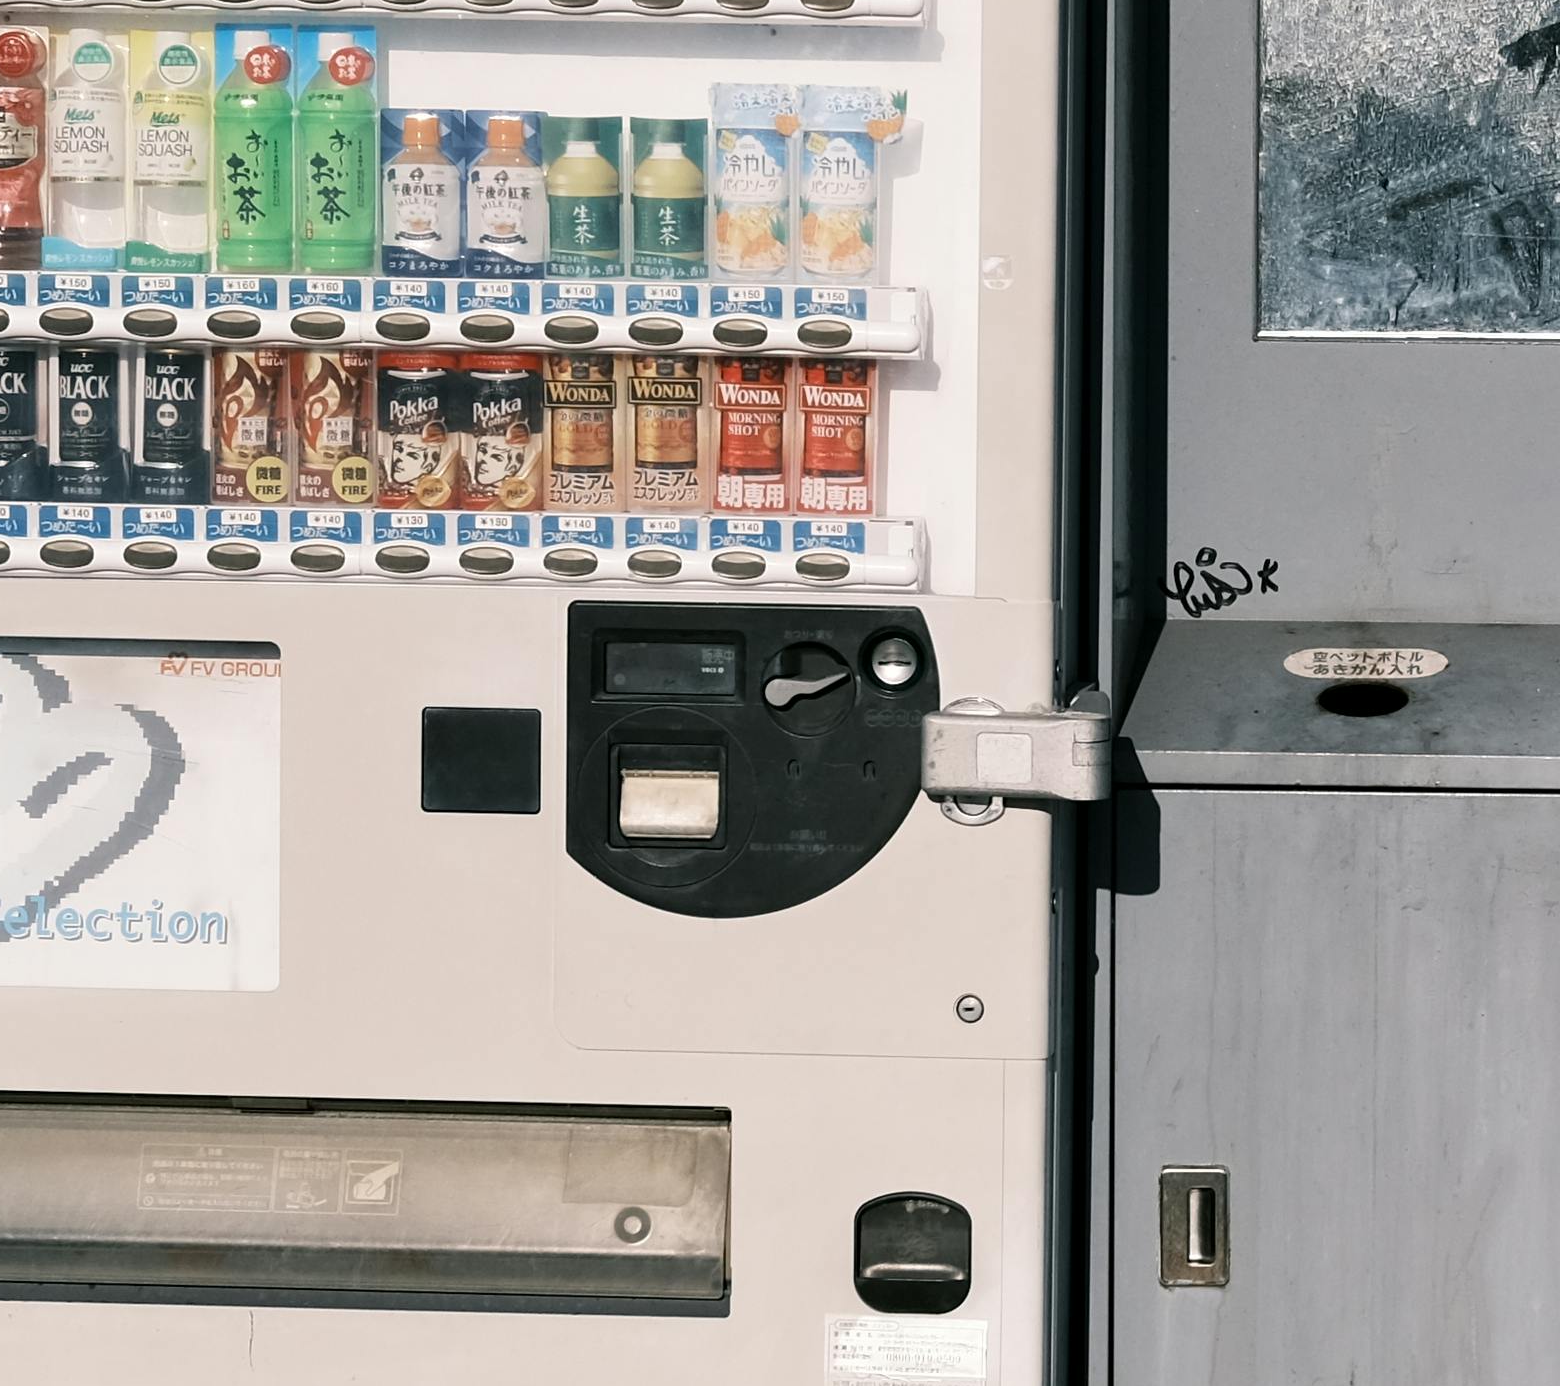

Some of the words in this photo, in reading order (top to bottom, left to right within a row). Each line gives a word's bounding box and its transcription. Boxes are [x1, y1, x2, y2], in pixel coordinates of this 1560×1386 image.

[55, 125, 105, 140] LEMON
[140, 129, 190, 143] LEMON
[53, 140, 110, 154] SQUASH
[138, 143, 193, 158] SQUASH
[725, 154, 776, 178] 冷やし
[814, 156, 865, 180] 冷やし
[392, 183, 447, 198] 午後の紅茶
[475, 185, 532, 200] 午後の紅茶
[572, 204, 595, 244] 生茶
[658, 206, 680, 246] 生茶
[388, 260, 450, 271] コクまろやか
[473, 263, 535, 274] コクまろやか
[310, 282, 340, 292] ¥160
[59, 376, 111, 400] BLACK
[547, 382, 609, 402] WONDA
[630, 380, 695, 399] WONDA
[718, 384, 781, 405] WONDA
[389, 396, 439, 419] Pokka
[473, 397, 522, 420] Pokka
[728, 412, 781, 425] MORNING
[811, 413, 864, 426] MORNING
[728, 424, 761, 436] SHOT
[811, 426, 844, 438] SHOT
[550, 472, 614, 490] プレミアム
[255, 485, 282, 495] FIRE
[341, 485, 368, 495] FIRE
[717, 475, 784, 508] 朝専用
[801, 477, 867, 510] 朝専用
[1312, 651, 1425, 663] 空ペットボトル
[191, 660, 215, 676] FV
[221, 661, 281, 678] GROU
[1312, 663, 1424, 675] あきかん入れ
